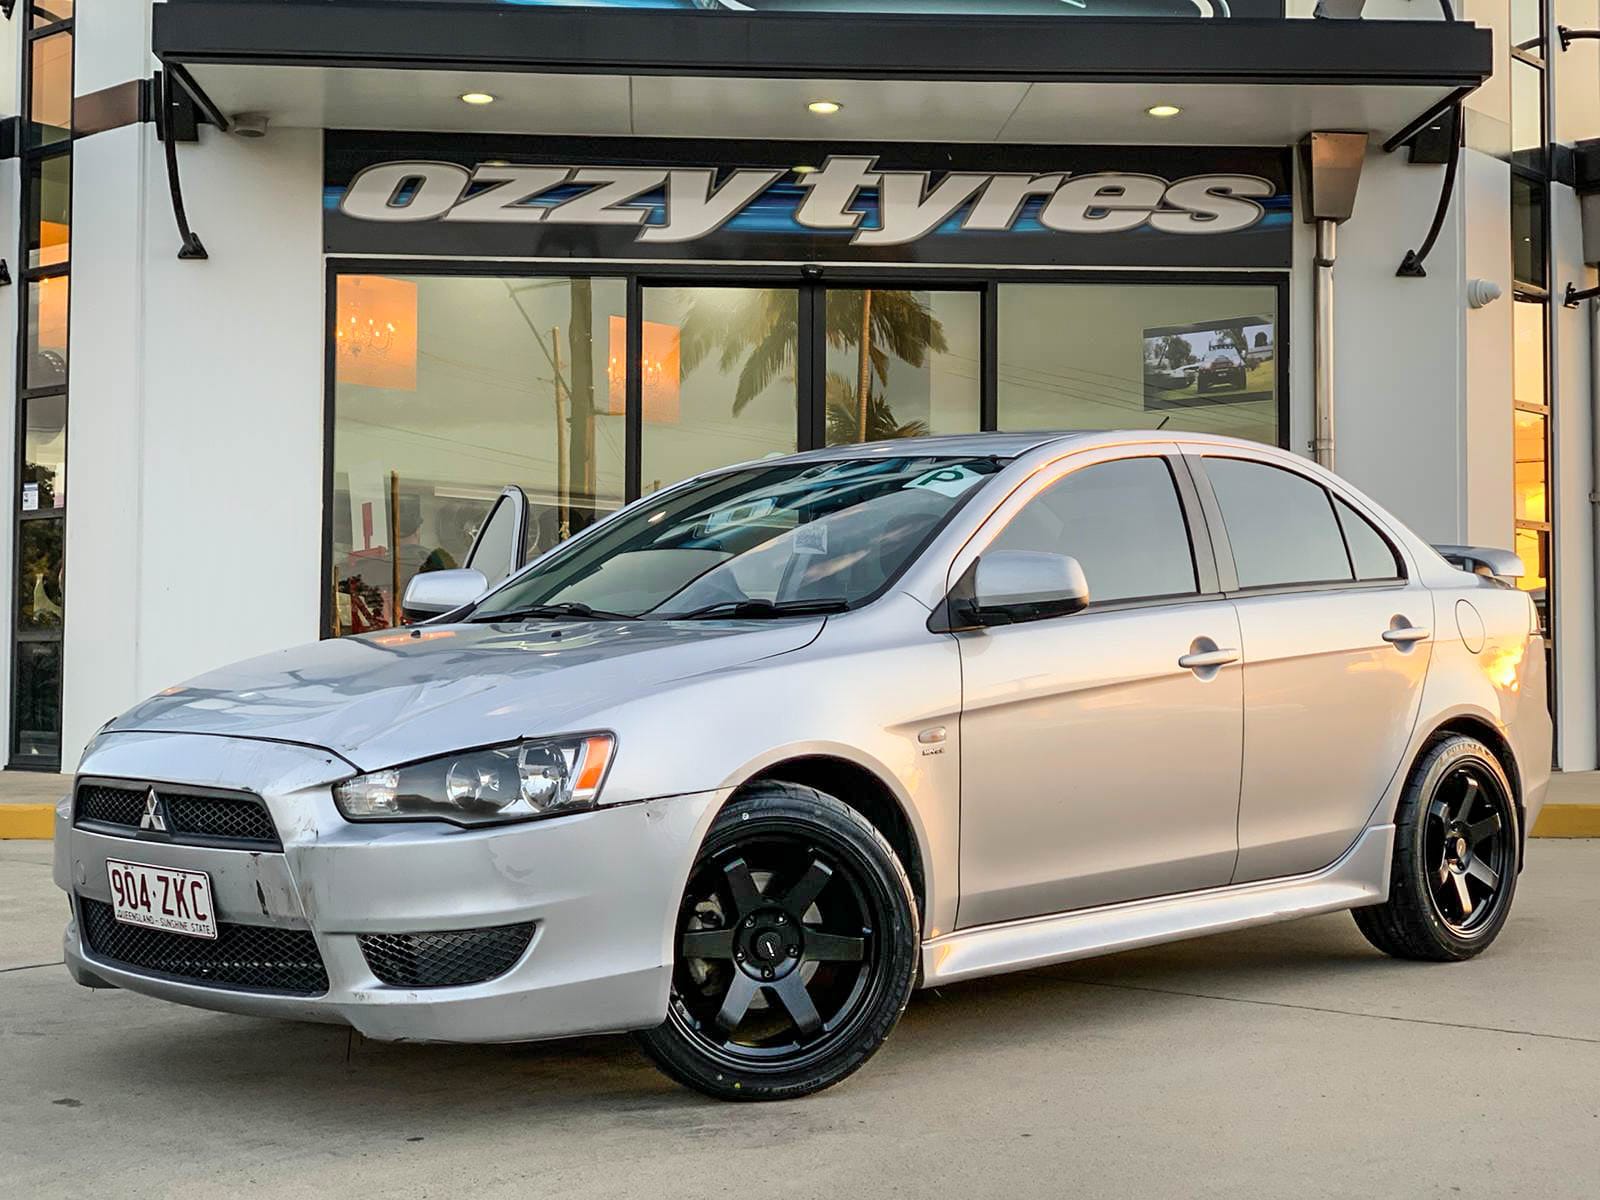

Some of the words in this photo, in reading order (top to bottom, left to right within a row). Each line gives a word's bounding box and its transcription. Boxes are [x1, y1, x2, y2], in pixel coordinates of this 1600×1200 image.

[340, 160, 790, 243] ozzy
[794, 154, 1276, 247] tyres
[917, 470, 964, 486] P
[117, 909, 154, 925] QUEENSLAND
[160, 917, 188, 931] SUNSHINE
[191, 922, 210, 935] STATE
